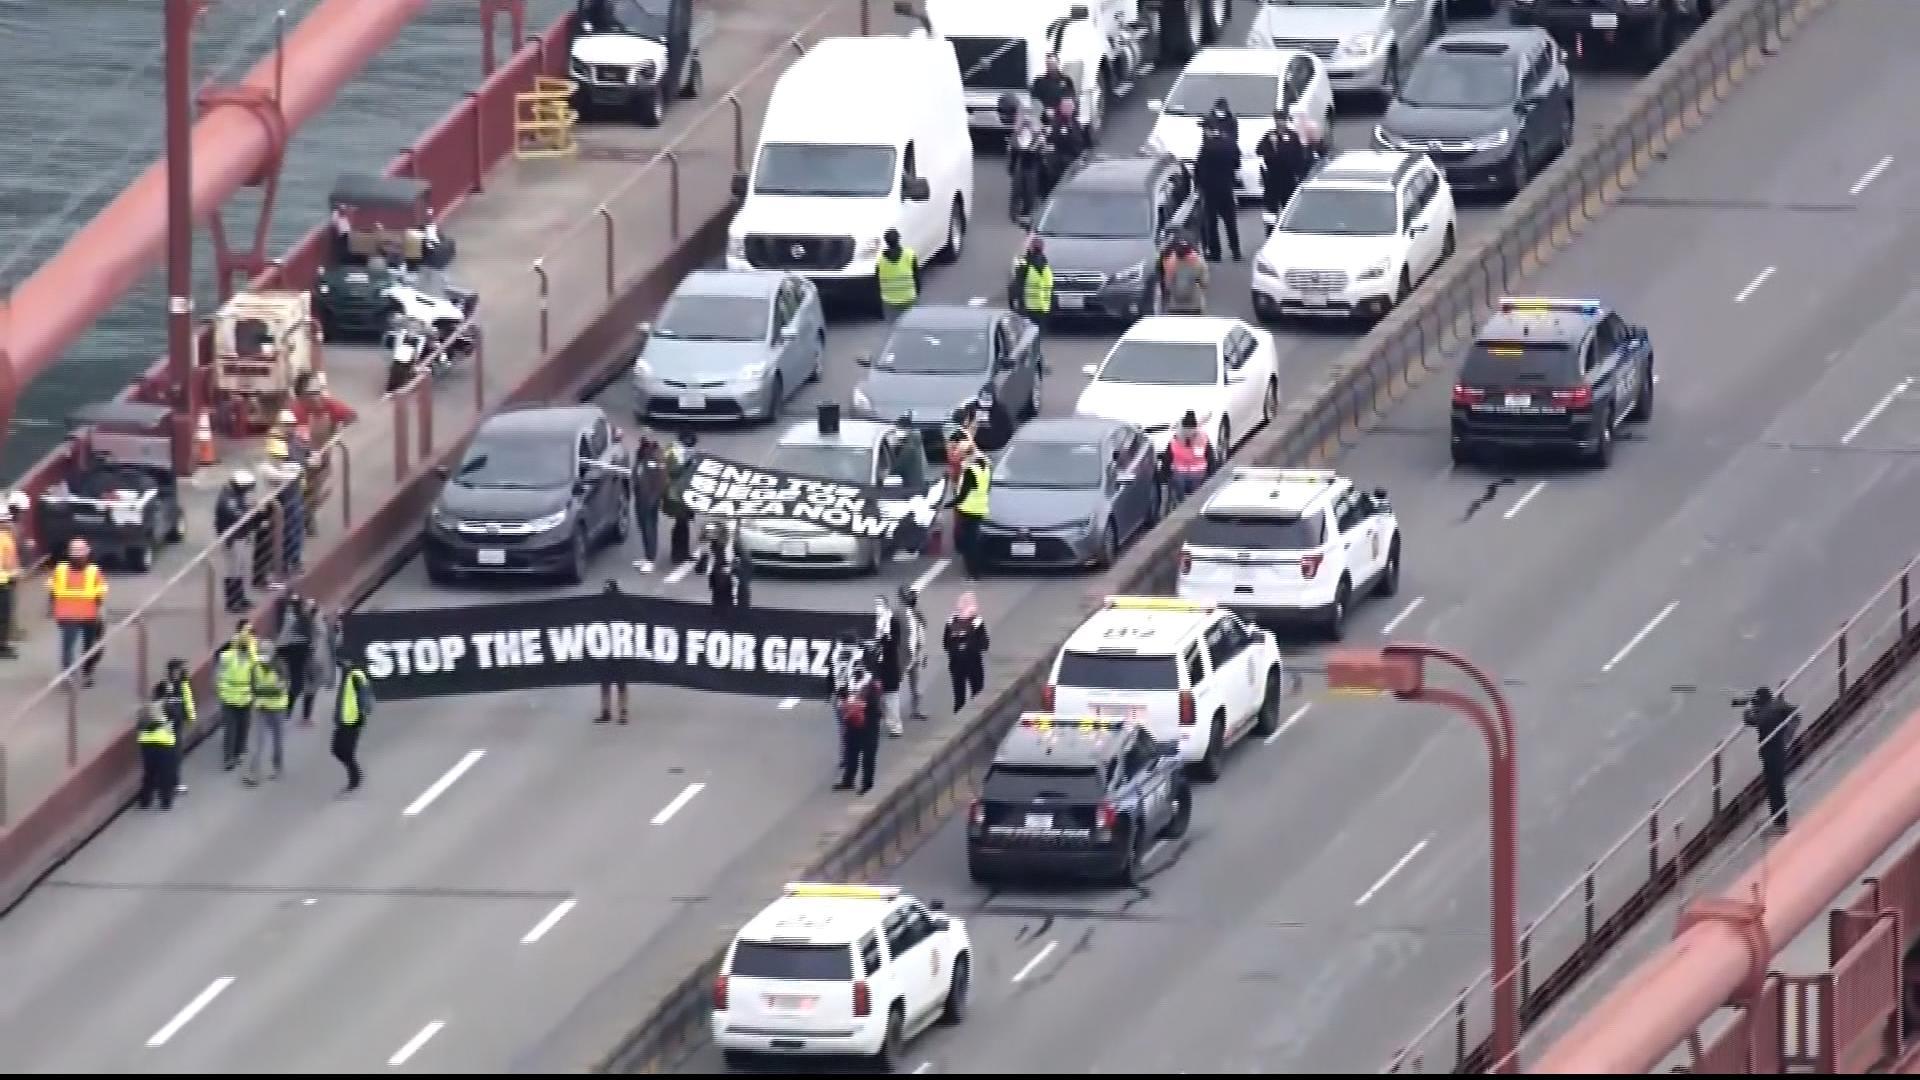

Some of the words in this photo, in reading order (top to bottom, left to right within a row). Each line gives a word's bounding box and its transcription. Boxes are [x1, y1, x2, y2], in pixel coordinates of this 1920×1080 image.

[696, 458, 778, 487] END
[683, 488, 785, 517] GAZA
[792, 501, 900, 539] NOW!
[365, 635, 466, 679] STOP
[471, 629, 545, 669] THE
[547, 621, 680, 664] WORLD
[686, 629, 757, 672] FOR
[762, 635, 838, 678] GAZ
